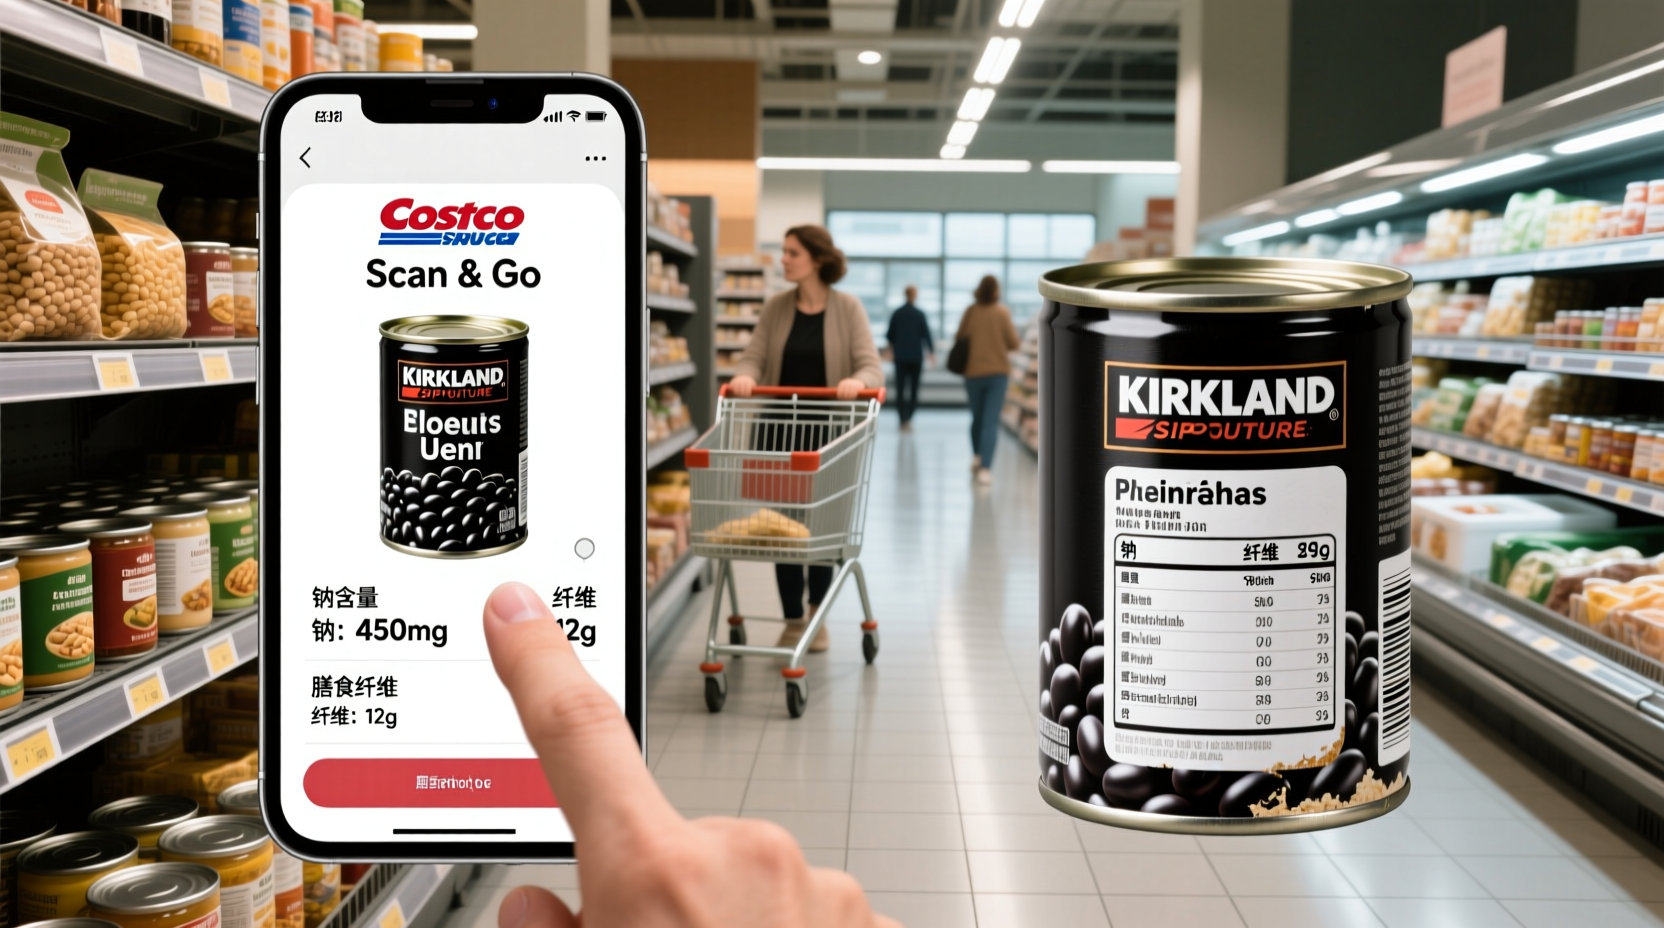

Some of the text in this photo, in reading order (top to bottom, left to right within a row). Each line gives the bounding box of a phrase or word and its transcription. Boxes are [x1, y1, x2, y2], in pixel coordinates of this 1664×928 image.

[381, 198, 525, 230] Costco
[366, 258, 541, 288] Scan & Go
[402, 366, 504, 387] KIRKLAND
[1119, 375, 1335, 416] KIRKLAND
[312, 585, 379, 609] 钠含量
[552, 585, 597, 609] 纤维
[355, 618, 448, 648] 450mg
[311, 675, 398, 698] 膳食纤维
[365, 707, 397, 729] 12g
